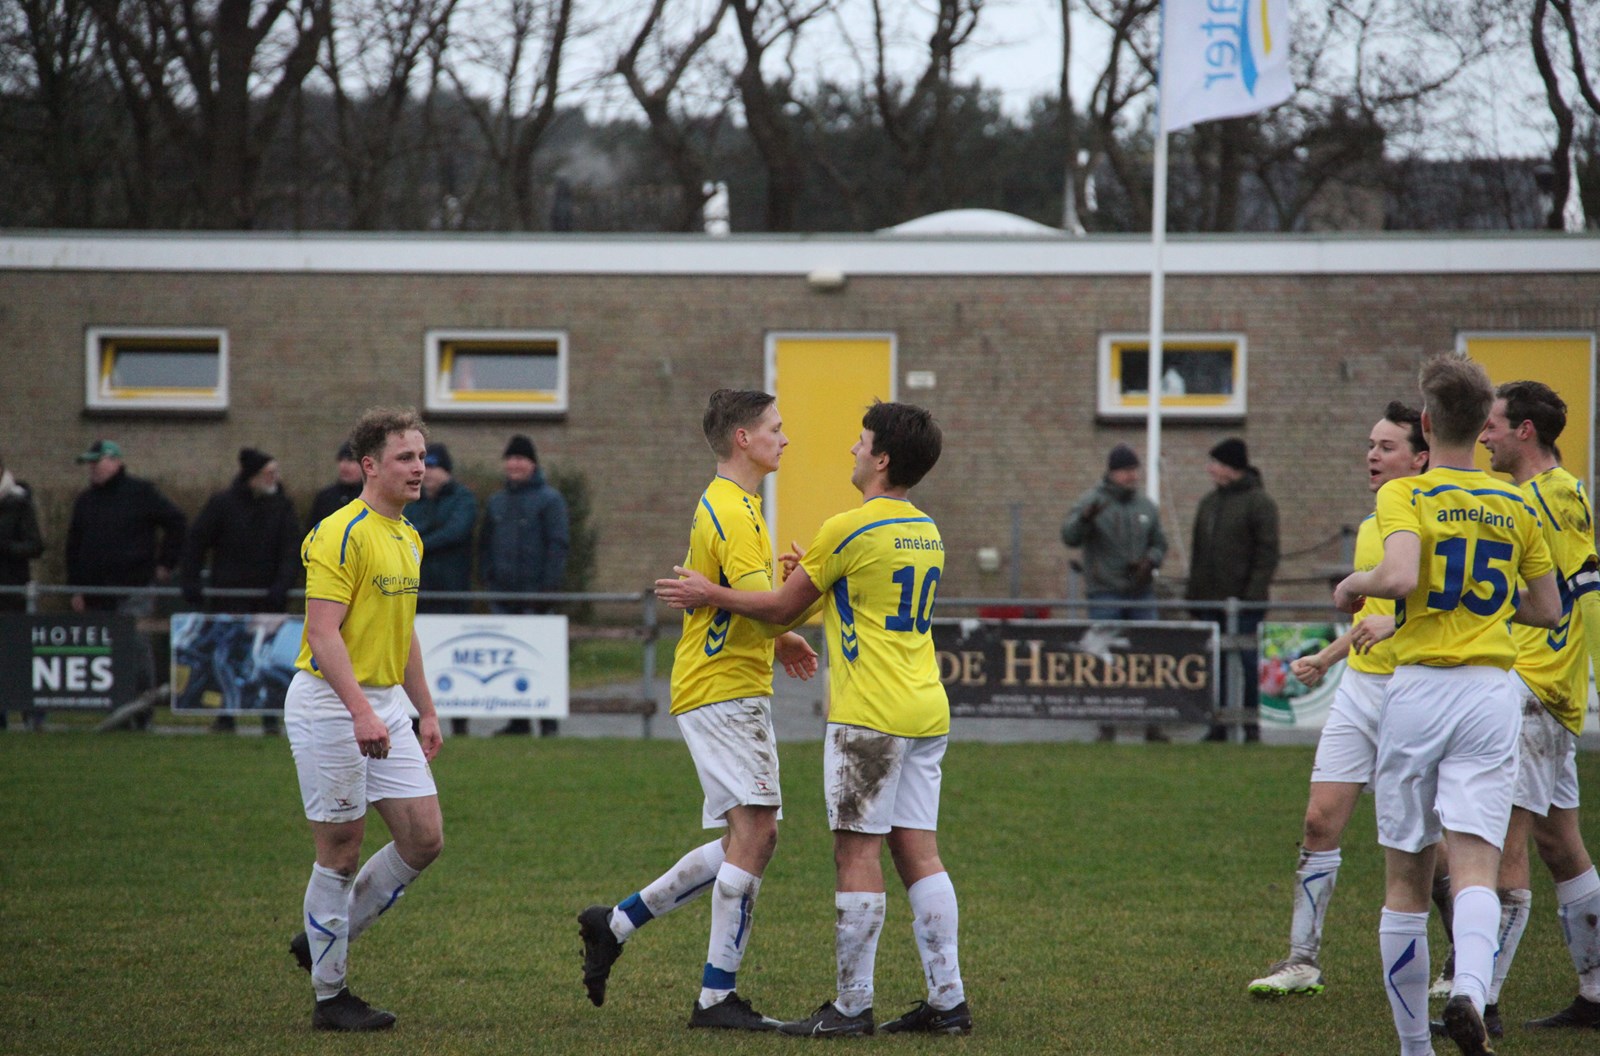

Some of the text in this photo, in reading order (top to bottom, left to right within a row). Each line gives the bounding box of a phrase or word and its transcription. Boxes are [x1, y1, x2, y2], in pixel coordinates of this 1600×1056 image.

[372, 574, 396, 587] Klein
[1427, 537, 1514, 616] 15
[885, 566, 940, 634] 10
[32, 626, 112, 645] HOTEL
[32, 656, 114, 691] NES
[453, 648, 516, 664] METZ
[938, 639, 1206, 690] DE HERBERG
